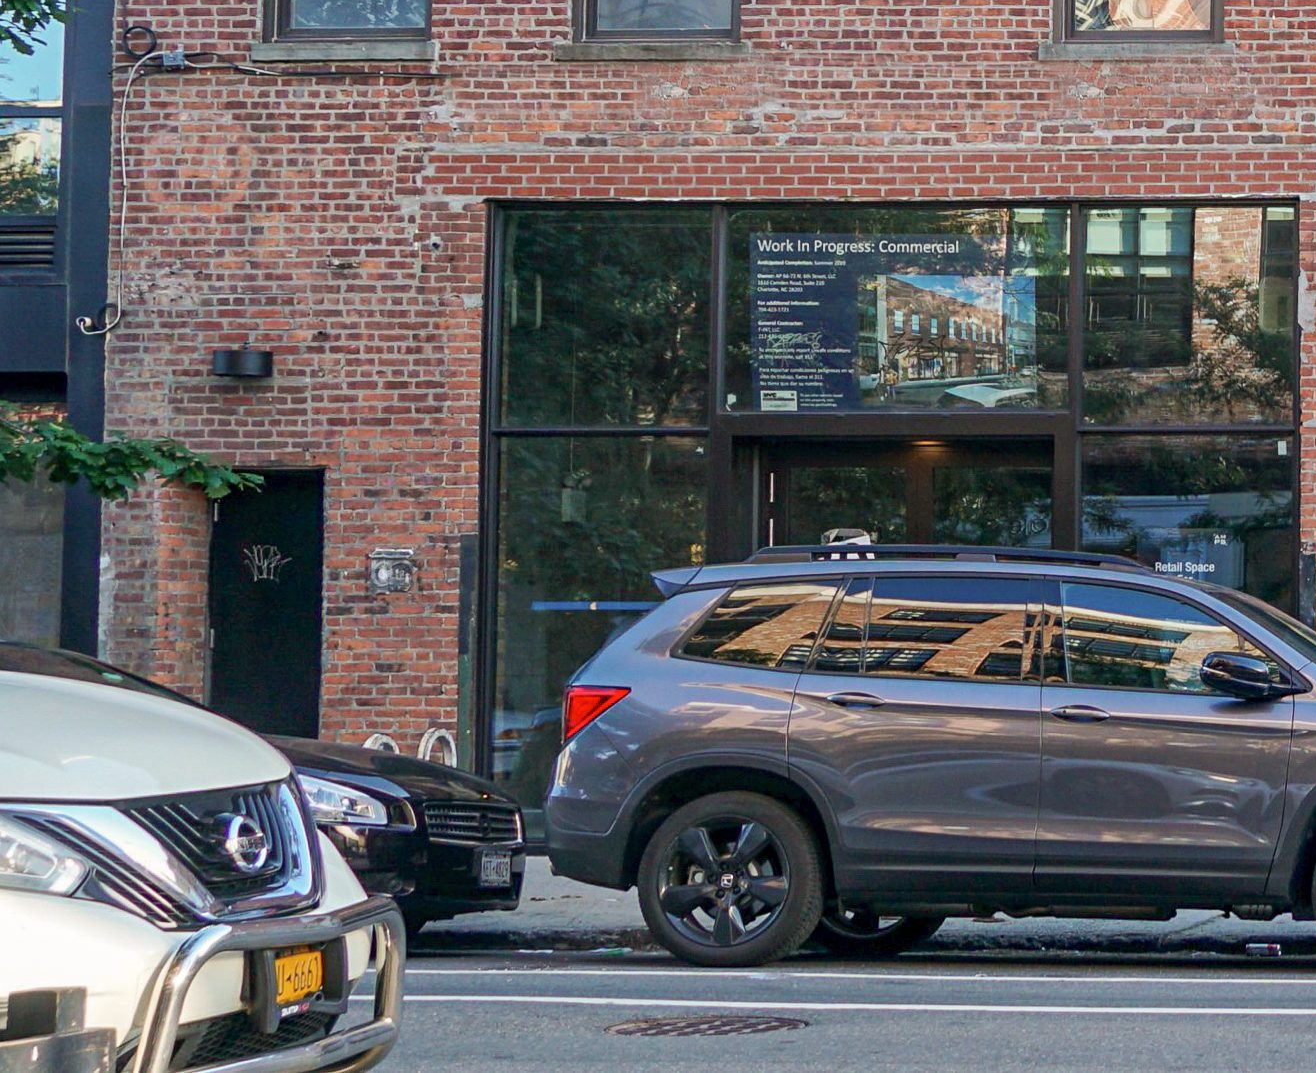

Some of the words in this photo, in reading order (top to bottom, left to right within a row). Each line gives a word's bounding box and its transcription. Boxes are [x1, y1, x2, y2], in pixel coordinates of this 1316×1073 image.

[757, 239, 794, 253] Work
[797, 240, 809, 253] In
[814, 240, 875, 255] Progress:
[878, 240, 960, 254] Commercial
[1155, 561, 1182, 572] Retail
[1185, 561, 1215, 574] Space
